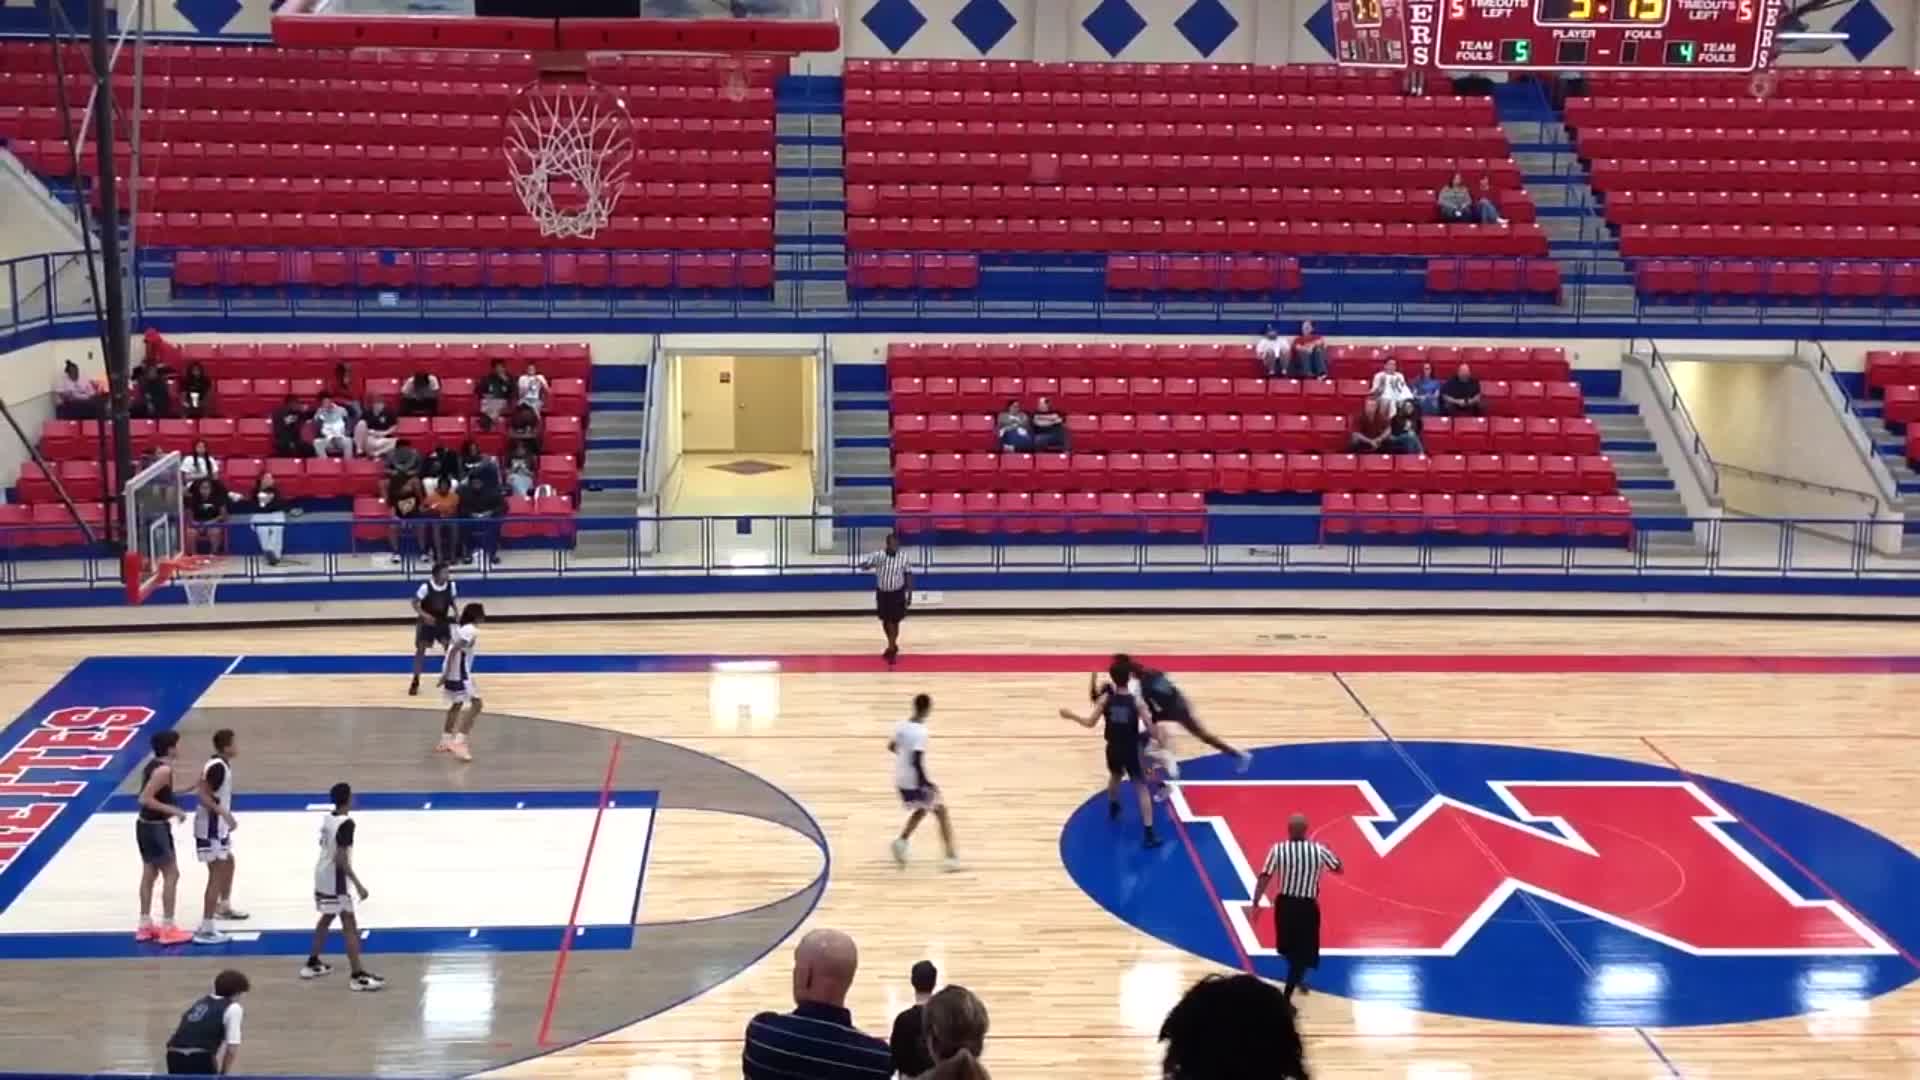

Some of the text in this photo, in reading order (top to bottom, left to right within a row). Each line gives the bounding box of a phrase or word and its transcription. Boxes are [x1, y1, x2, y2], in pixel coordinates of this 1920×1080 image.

[1471, 0, 1529, 8] TIMEOUTS
[1679, 0, 1736, 10] TIMEOUTS
[1482, 8, 1513, 18] LEFT
[1689, 9, 1719, 20] LEFT
[1740, 0, 1752, 20] 5
[1409, 0, 1434, 65] ERS
[1552, 29, 1596, 39] PLAYER
[1624, 29, 1662, 39] FOULS
[1459, 40, 1493, 50] TEAM
[1703, 43, 1736, 52] TEAM
[1455, 51, 1493, 61] FOULS
[1515, 40, 1528, 62] 5
[1680, 43, 1693, 62] 4
[1698, 53, 1736, 63] FOULS
